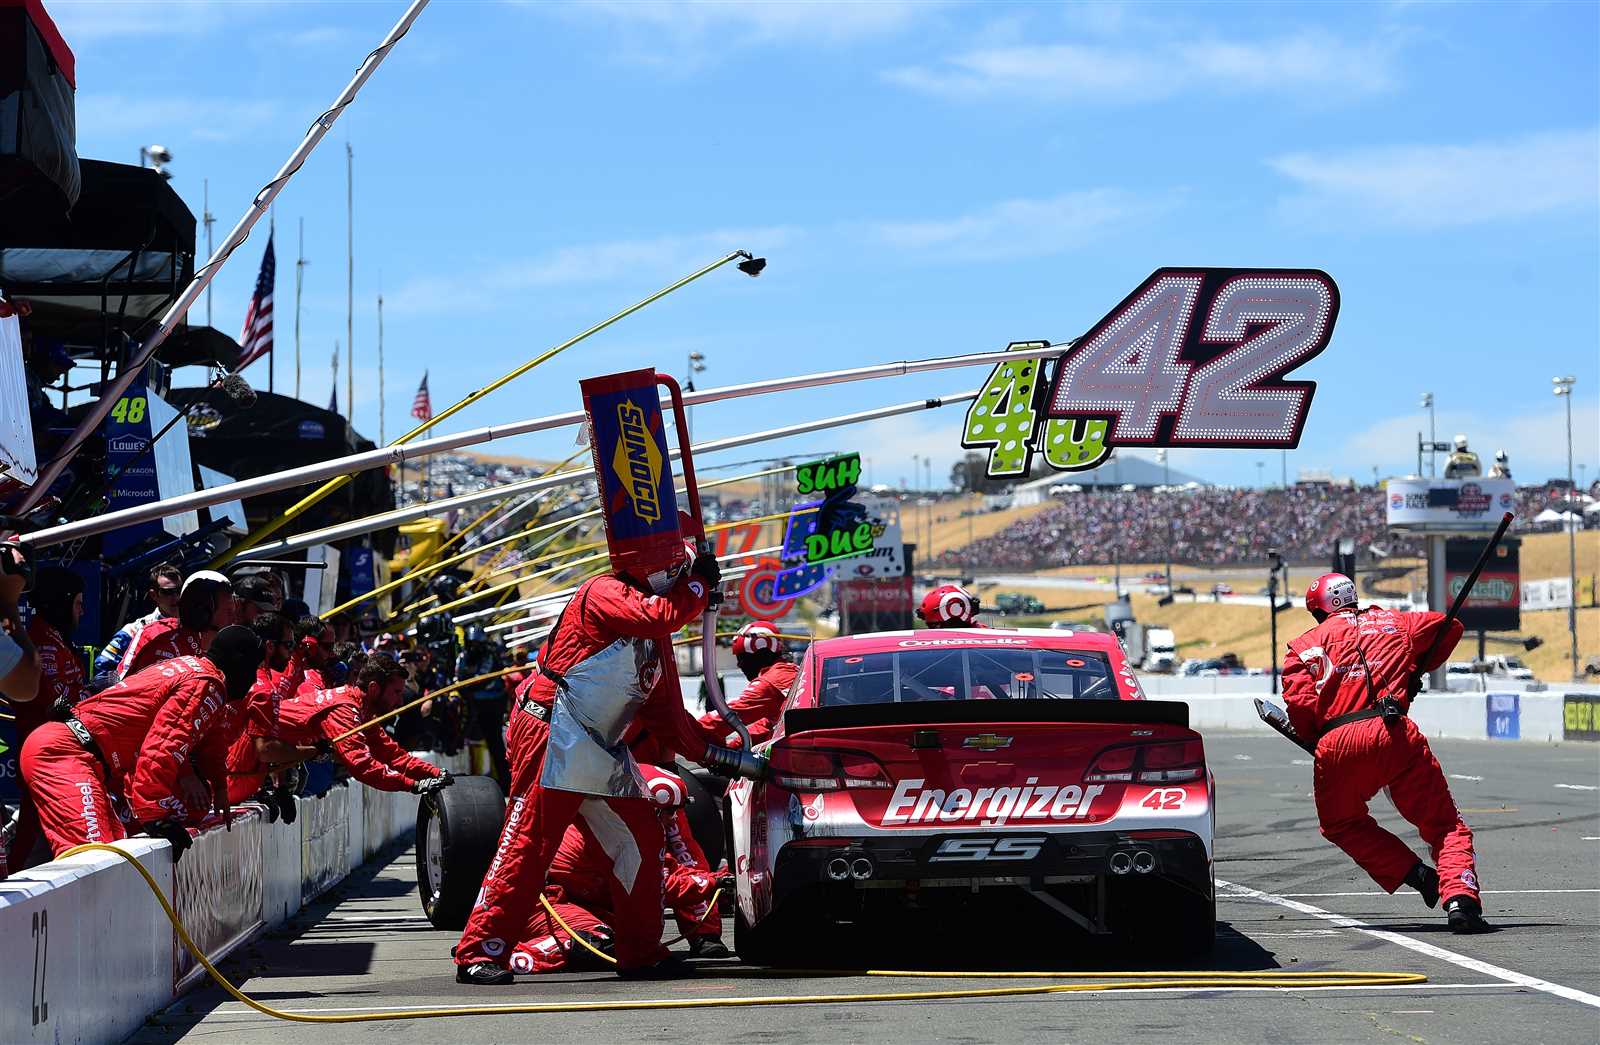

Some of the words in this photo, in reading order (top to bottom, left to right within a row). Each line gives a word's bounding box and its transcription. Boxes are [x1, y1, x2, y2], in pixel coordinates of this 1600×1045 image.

[1052, 273, 1333, 442] 42
[111, 397, 146, 423] 48
[618, 406, 657, 517] SUNOCO
[117, 489, 154, 497] Microsoft
[881, 776, 1104, 828] Energizer
[1141, 788, 1187, 811] 42
[486, 795, 526, 882] cartwheel
[929, 836, 1048, 863] SS
